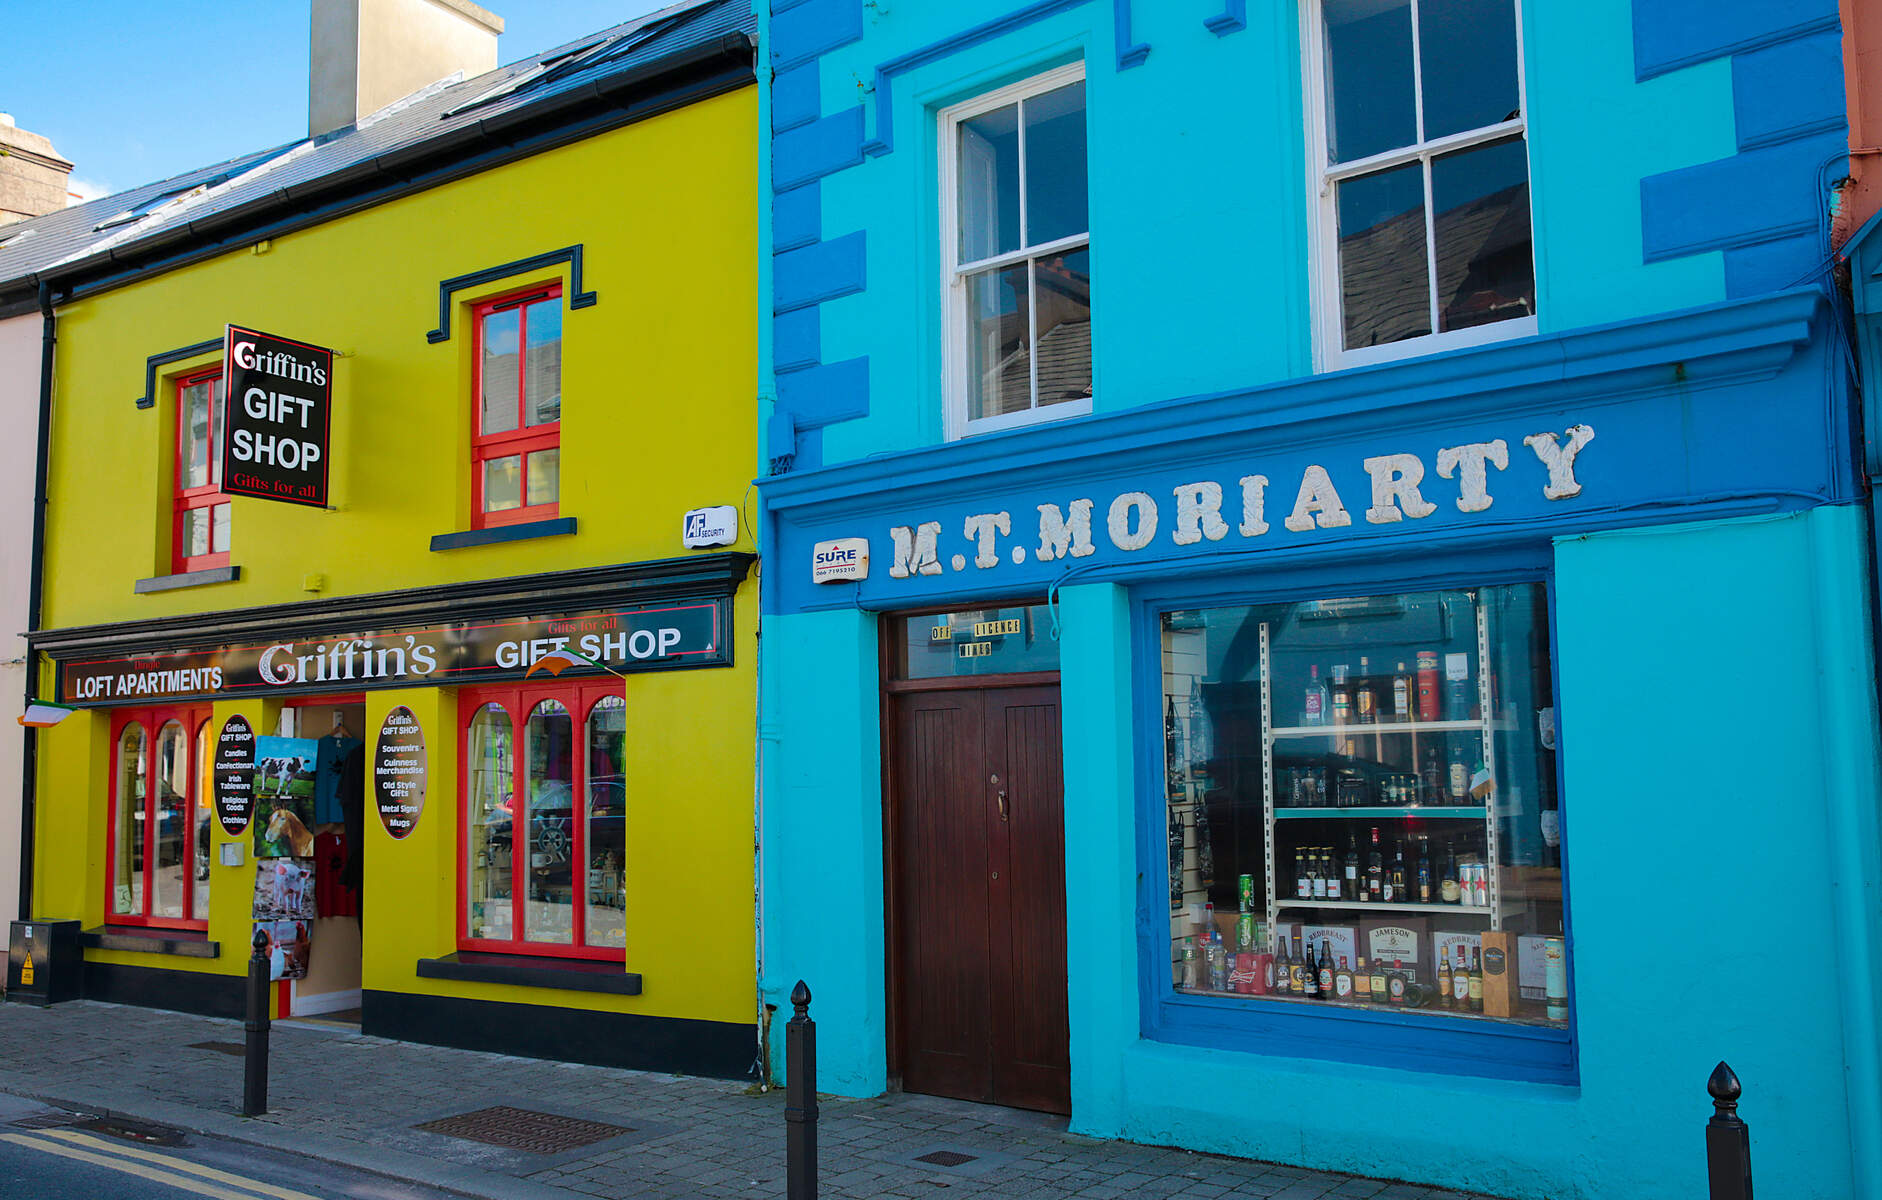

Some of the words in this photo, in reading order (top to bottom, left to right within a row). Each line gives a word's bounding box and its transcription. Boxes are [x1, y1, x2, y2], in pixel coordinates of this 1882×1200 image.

[233, 341, 327, 387] Griffin's
[244, 387, 315, 429] GIFT
[232, 429, 321, 472] SHOP
[233, 472, 269, 490] Gifts
[274, 479, 295, 494] for
[298, 484, 316, 498] all
[687, 513, 705, 538] AF
[701, 527, 725, 538] SECURITY
[815, 549, 857, 564] SURE
[547, 621, 577, 635] Gifts
[580, 619, 598, 632] for
[601, 617, 617, 631] all
[932, 627, 950, 640] OFF
[975, 620, 1020, 636] LICENCE
[495, 636, 570, 669] GIFT
[579, 627, 682, 662] SHOP
[959, 642, 991, 657] WINES
[258, 635, 437, 685] Griffin's
[76, 674, 113, 699] LOFT
[115, 666, 223, 696] APARTMENTS
[382, 727, 398, 735] GIFT
[399, 726, 419, 734] SHOP
[220, 734, 234, 742] GIFT
[235, 733, 252, 741] SHOP
[382, 744, 419, 752] Souvenirs
[384, 759, 418, 767] Guinness
[376, 766, 424, 775] Merchandise
[220, 782, 251, 790] Tableware
[382, 781, 395, 789] Old
[396, 781, 416, 790] Style
[390, 789, 408, 797] Gifts
[381, 805, 399, 813] Metal
[400, 805, 418, 813] Signs
[390, 819, 410, 828] Mugs
[1375, 928, 1410, 938] JAMESON
